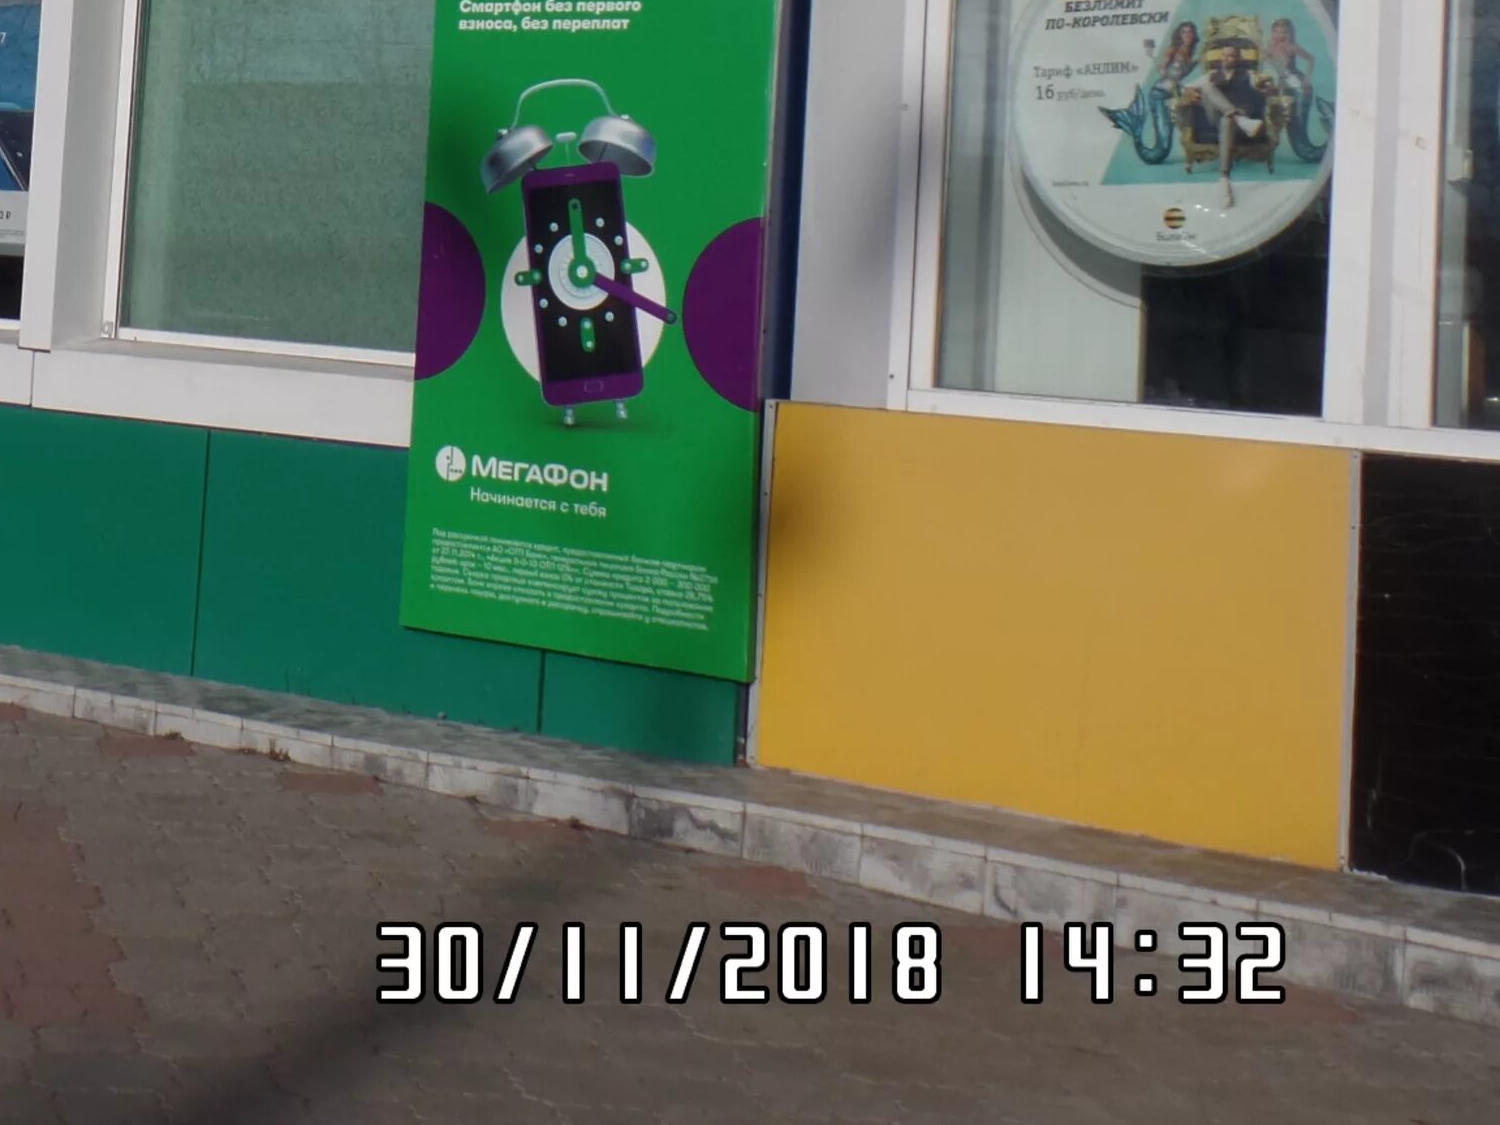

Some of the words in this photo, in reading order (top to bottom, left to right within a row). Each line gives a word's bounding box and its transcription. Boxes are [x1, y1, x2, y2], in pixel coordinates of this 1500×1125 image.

[459, 0, 542, 15] Смартфон
[576, 0, 642, 14] первого
[458, 17, 518, 32] взноса,
[521, 16, 548, 31] без
[551, 17, 630, 32] переплат
[1045, 11, 1170, 30] ПО-КОРОЛЕВСКИ
[1036, 85, 1055, 100] 16
[470, 486, 556, 511] Начинается
[560, 502, 569, 513] с
[573, 501, 607, 518] тебя
